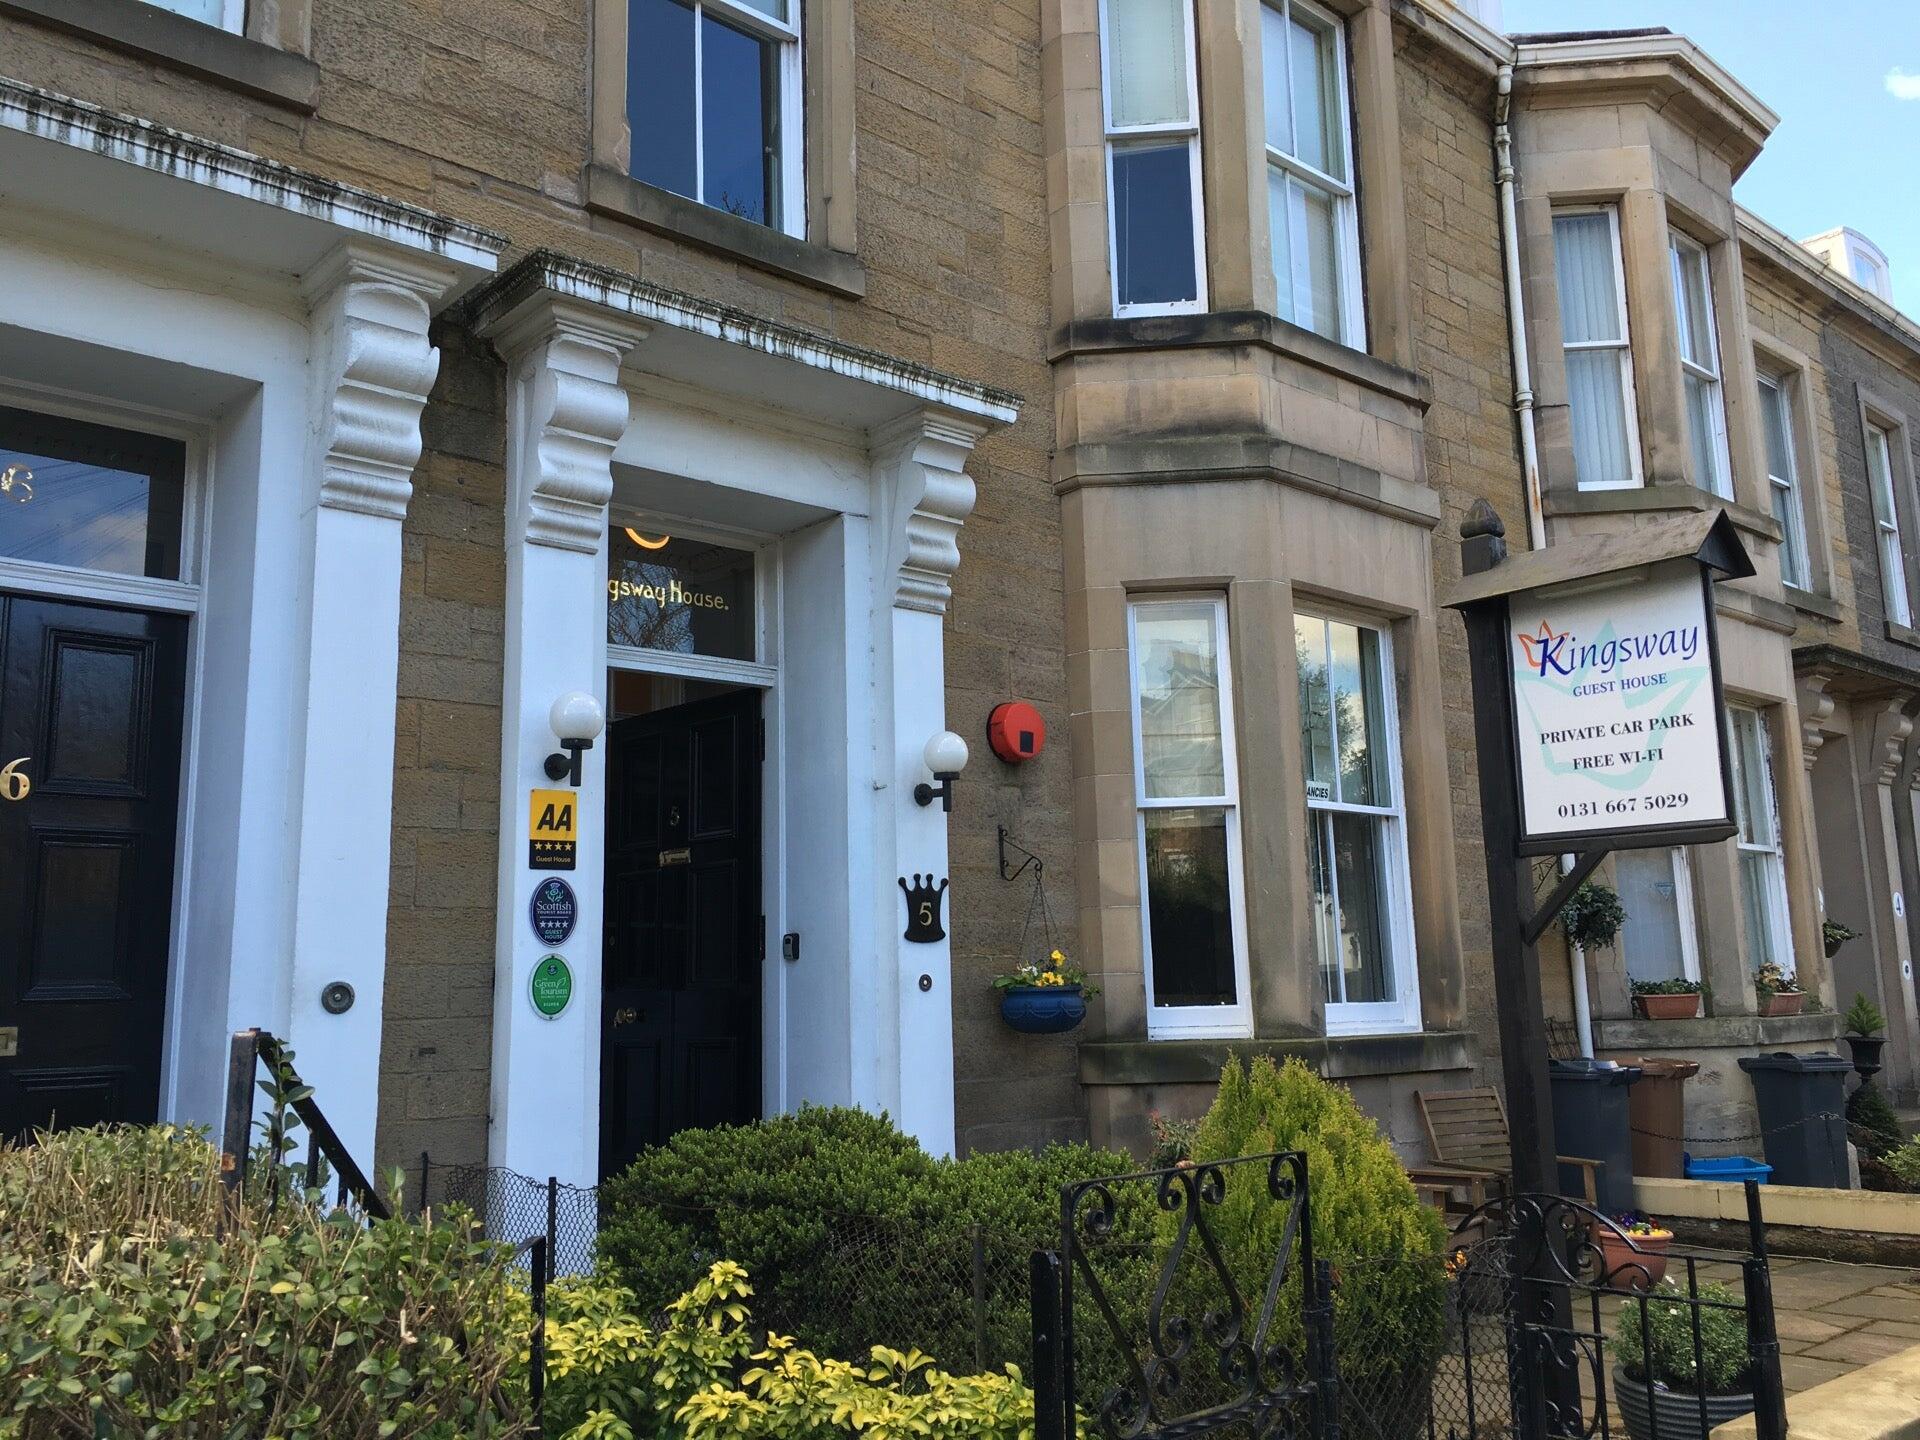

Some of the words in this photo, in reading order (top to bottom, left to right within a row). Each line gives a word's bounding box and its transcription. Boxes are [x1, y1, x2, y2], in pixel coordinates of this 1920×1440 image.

[670, 579, 729, 610] House.
[1536, 626, 1698, 677] Kingsway
[1573, 681, 1615, 697] GUEST
[1621, 673, 1668, 690] HOUSE
[1541, 725, 1606, 745] PRIVATE
[1611, 720, 1644, 735] CAR
[1649, 713, 1694, 731] PARK
[1573, 754, 1615, 770] FREE
[1620, 748, 1664, 764] WI-FI
[0, 757, 31, 800] 6
[536, 803, 572, 831] AA
[1558, 801, 1599, 818] 0131
[1605, 798, 1637, 813] 667
[1644, 793, 1689, 811] 5029
[536, 900, 572, 911] Scottish
[919, 902, 932, 926] 5
[534, 979, 556, 988] Green
[540, 986, 568, 995] Tourism
